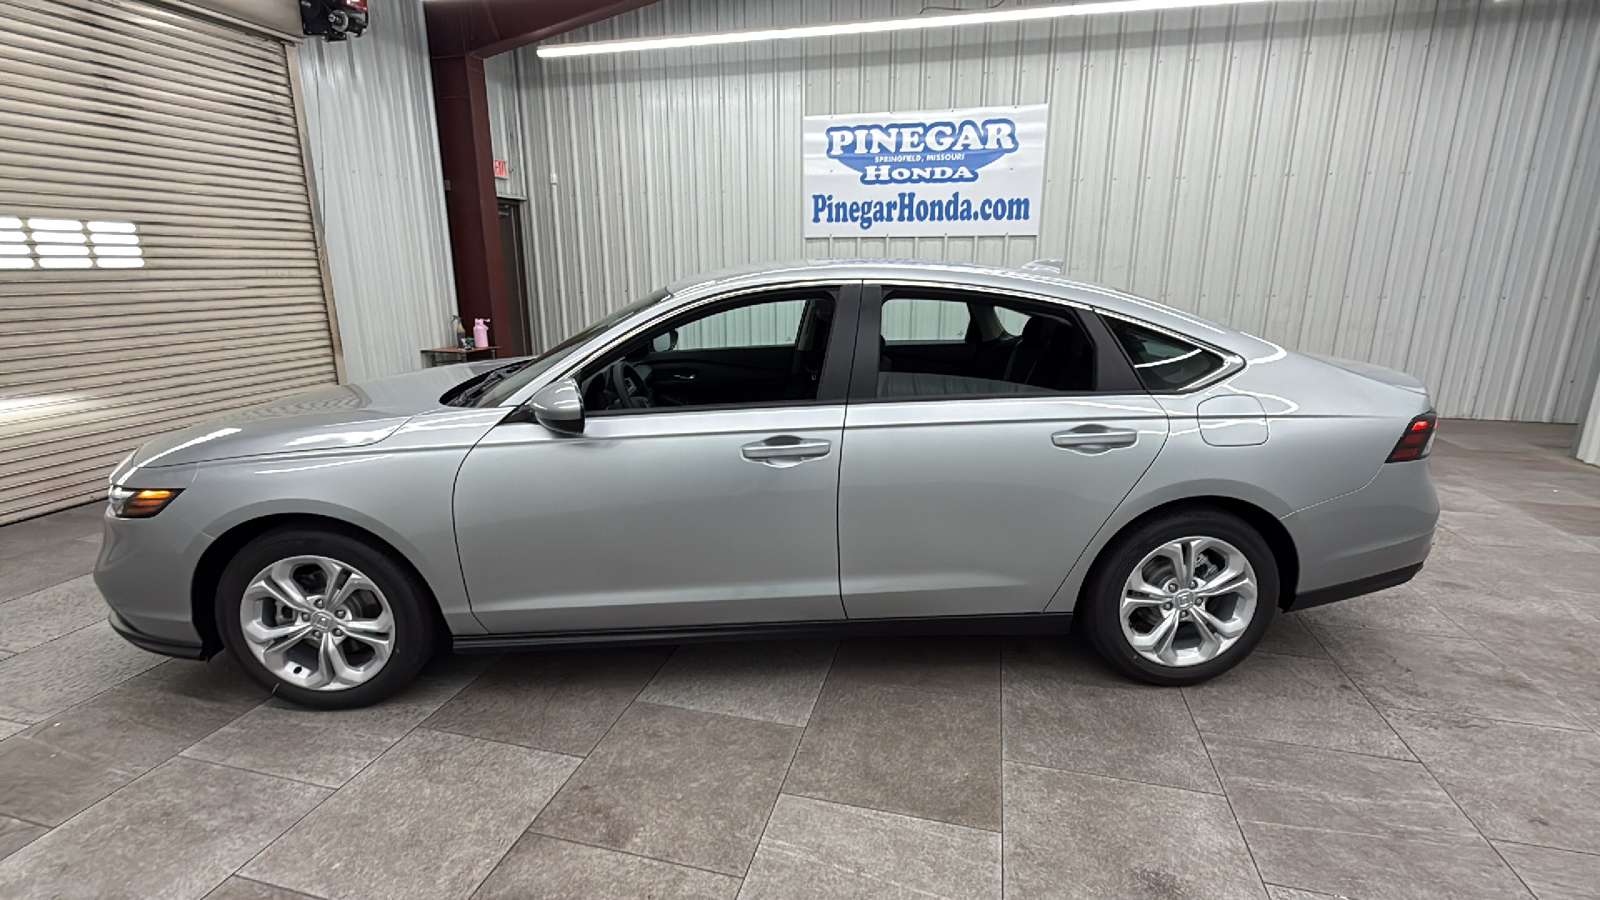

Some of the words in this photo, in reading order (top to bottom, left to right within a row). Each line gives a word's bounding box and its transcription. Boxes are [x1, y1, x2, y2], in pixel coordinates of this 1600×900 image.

[829, 122, 1016, 156] PINEGAR
[494, 159, 507, 176] EXIT
[874, 154, 924, 163] SPRINGFIELD,
[926, 152, 965, 161] MISSOURI
[812, 192, 1031, 230] PinegarHonda.com
